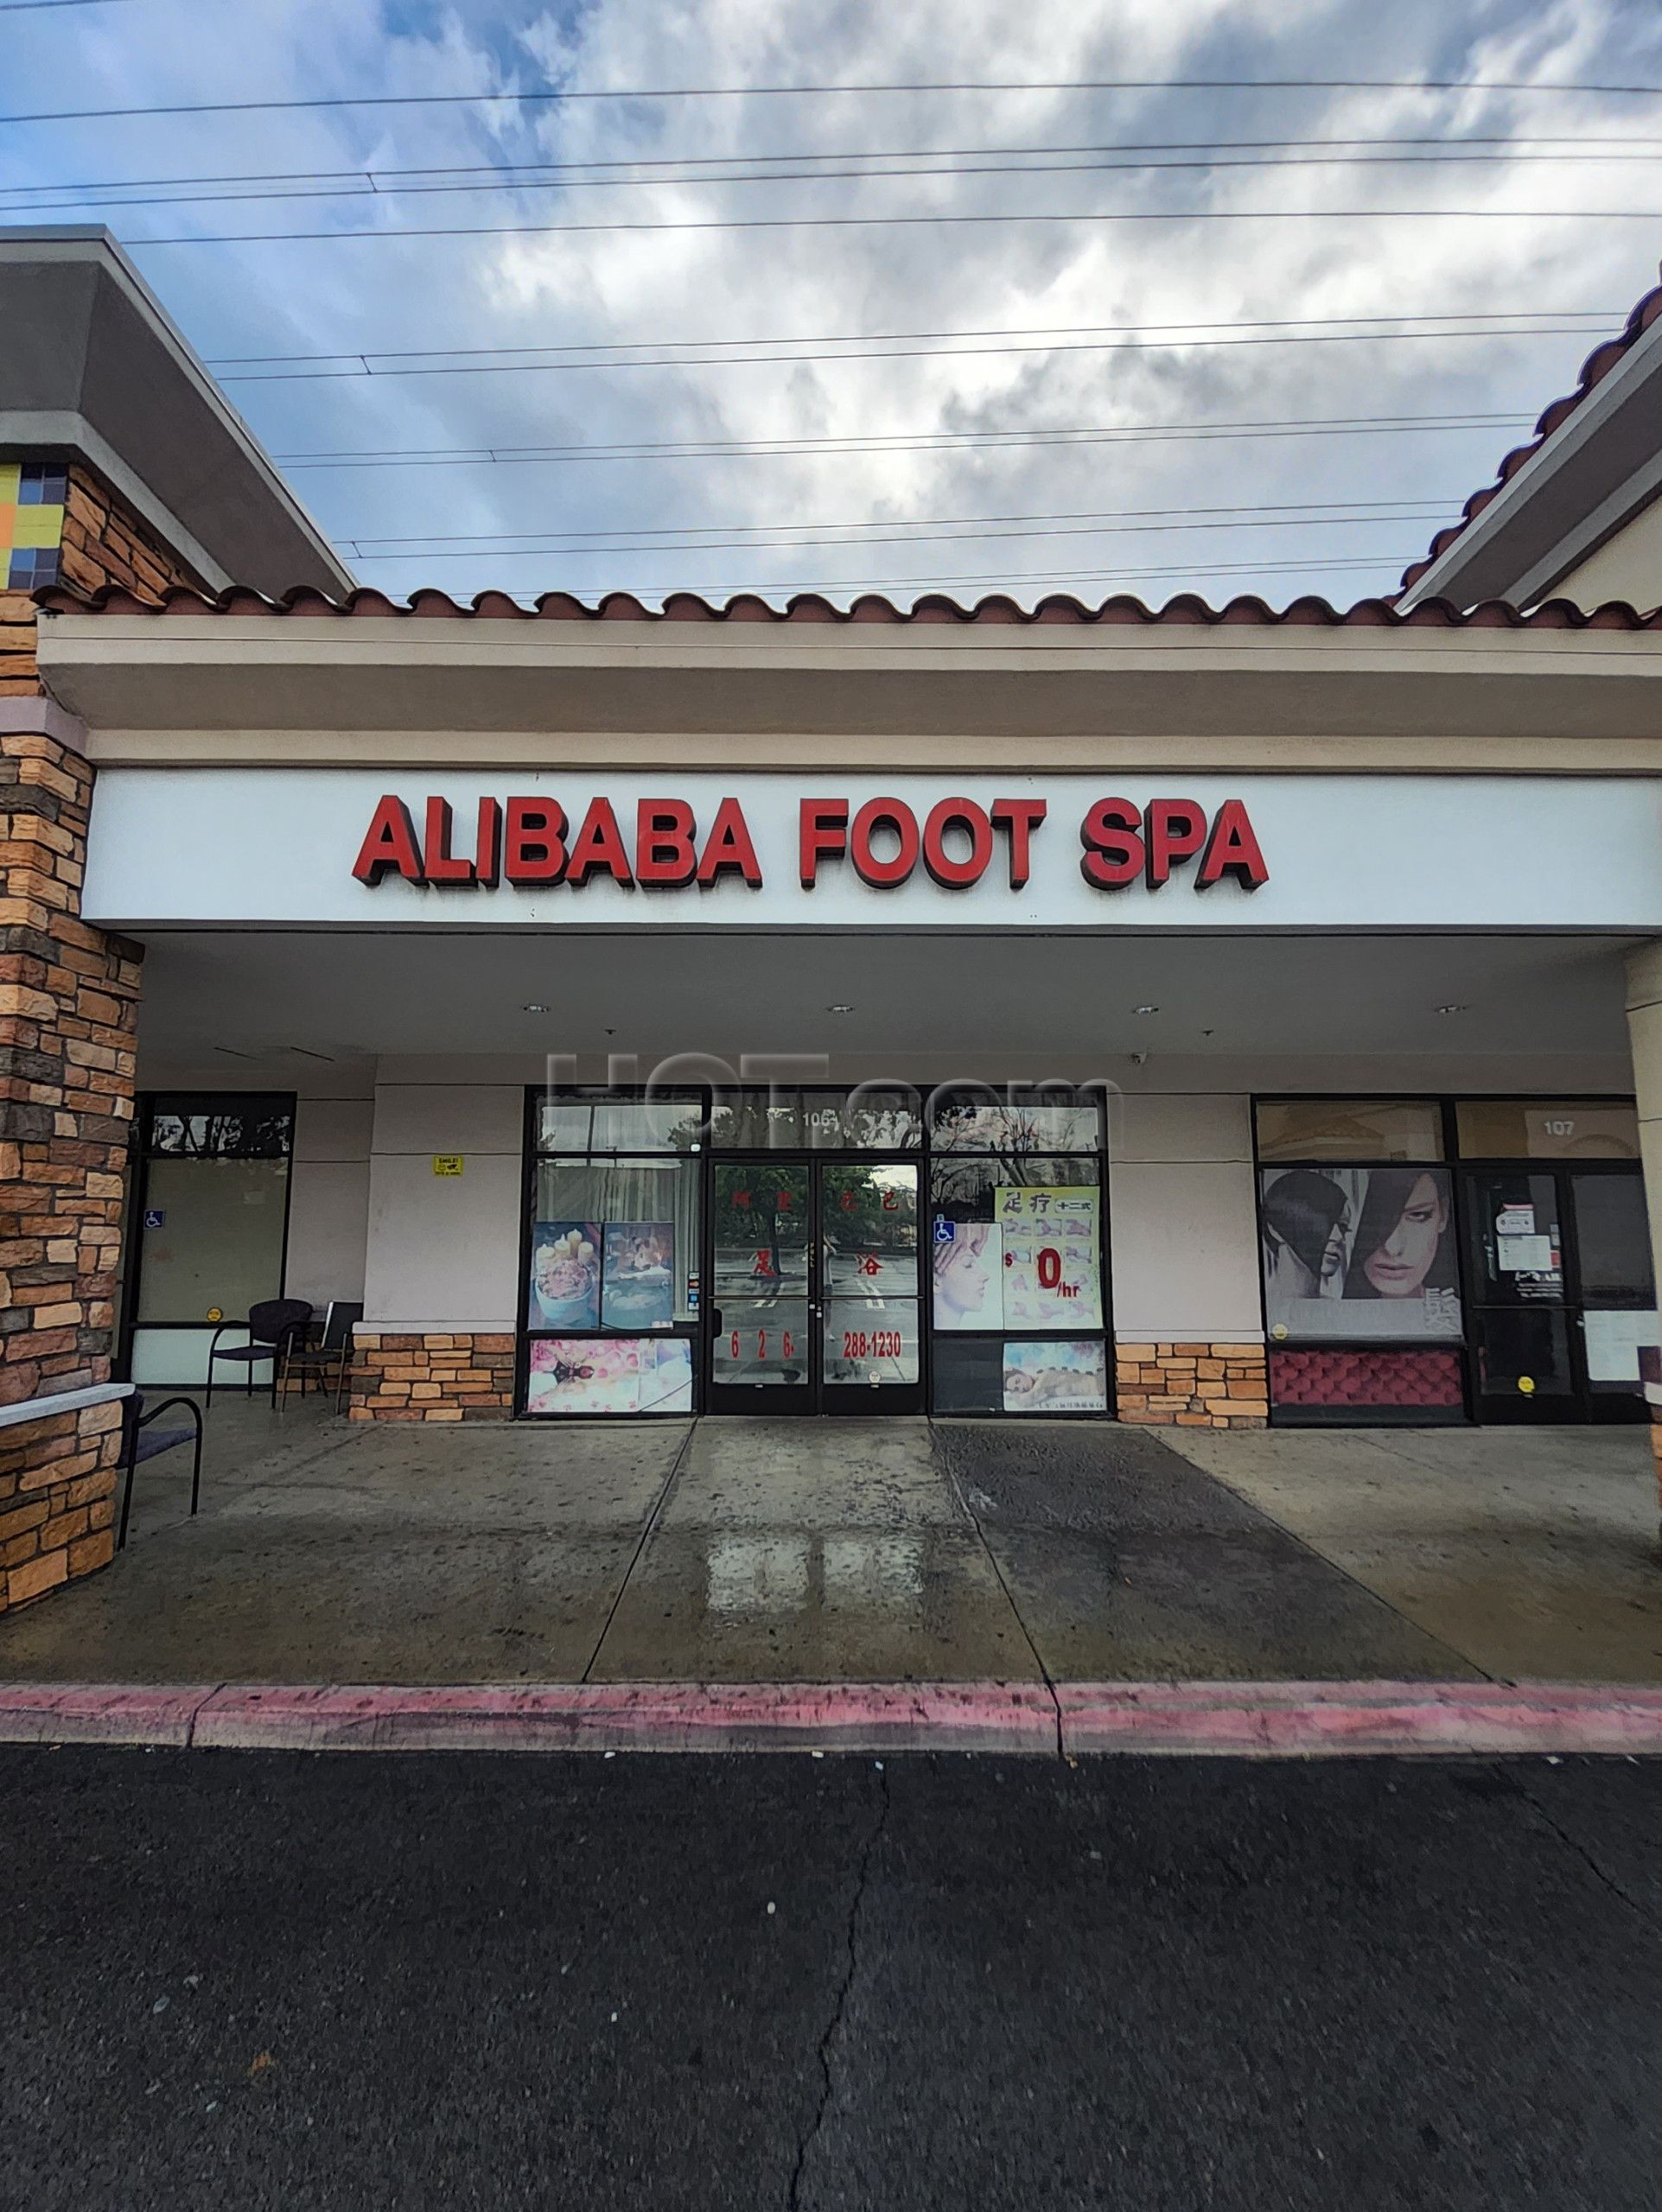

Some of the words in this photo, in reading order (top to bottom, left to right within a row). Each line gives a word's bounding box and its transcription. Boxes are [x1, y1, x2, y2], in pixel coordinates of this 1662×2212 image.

[351, 795, 763, 889] ALIBABA
[799, 797, 1047, 890] FOOT
[1079, 797, 1270, 891] SPA
[802, 1112, 831, 1127] 106
[1544, 1121, 1574, 1135] 107
[1057, 1201, 1092, 1211] 十二式
[843, 1332, 901, 1357] 288-1230
